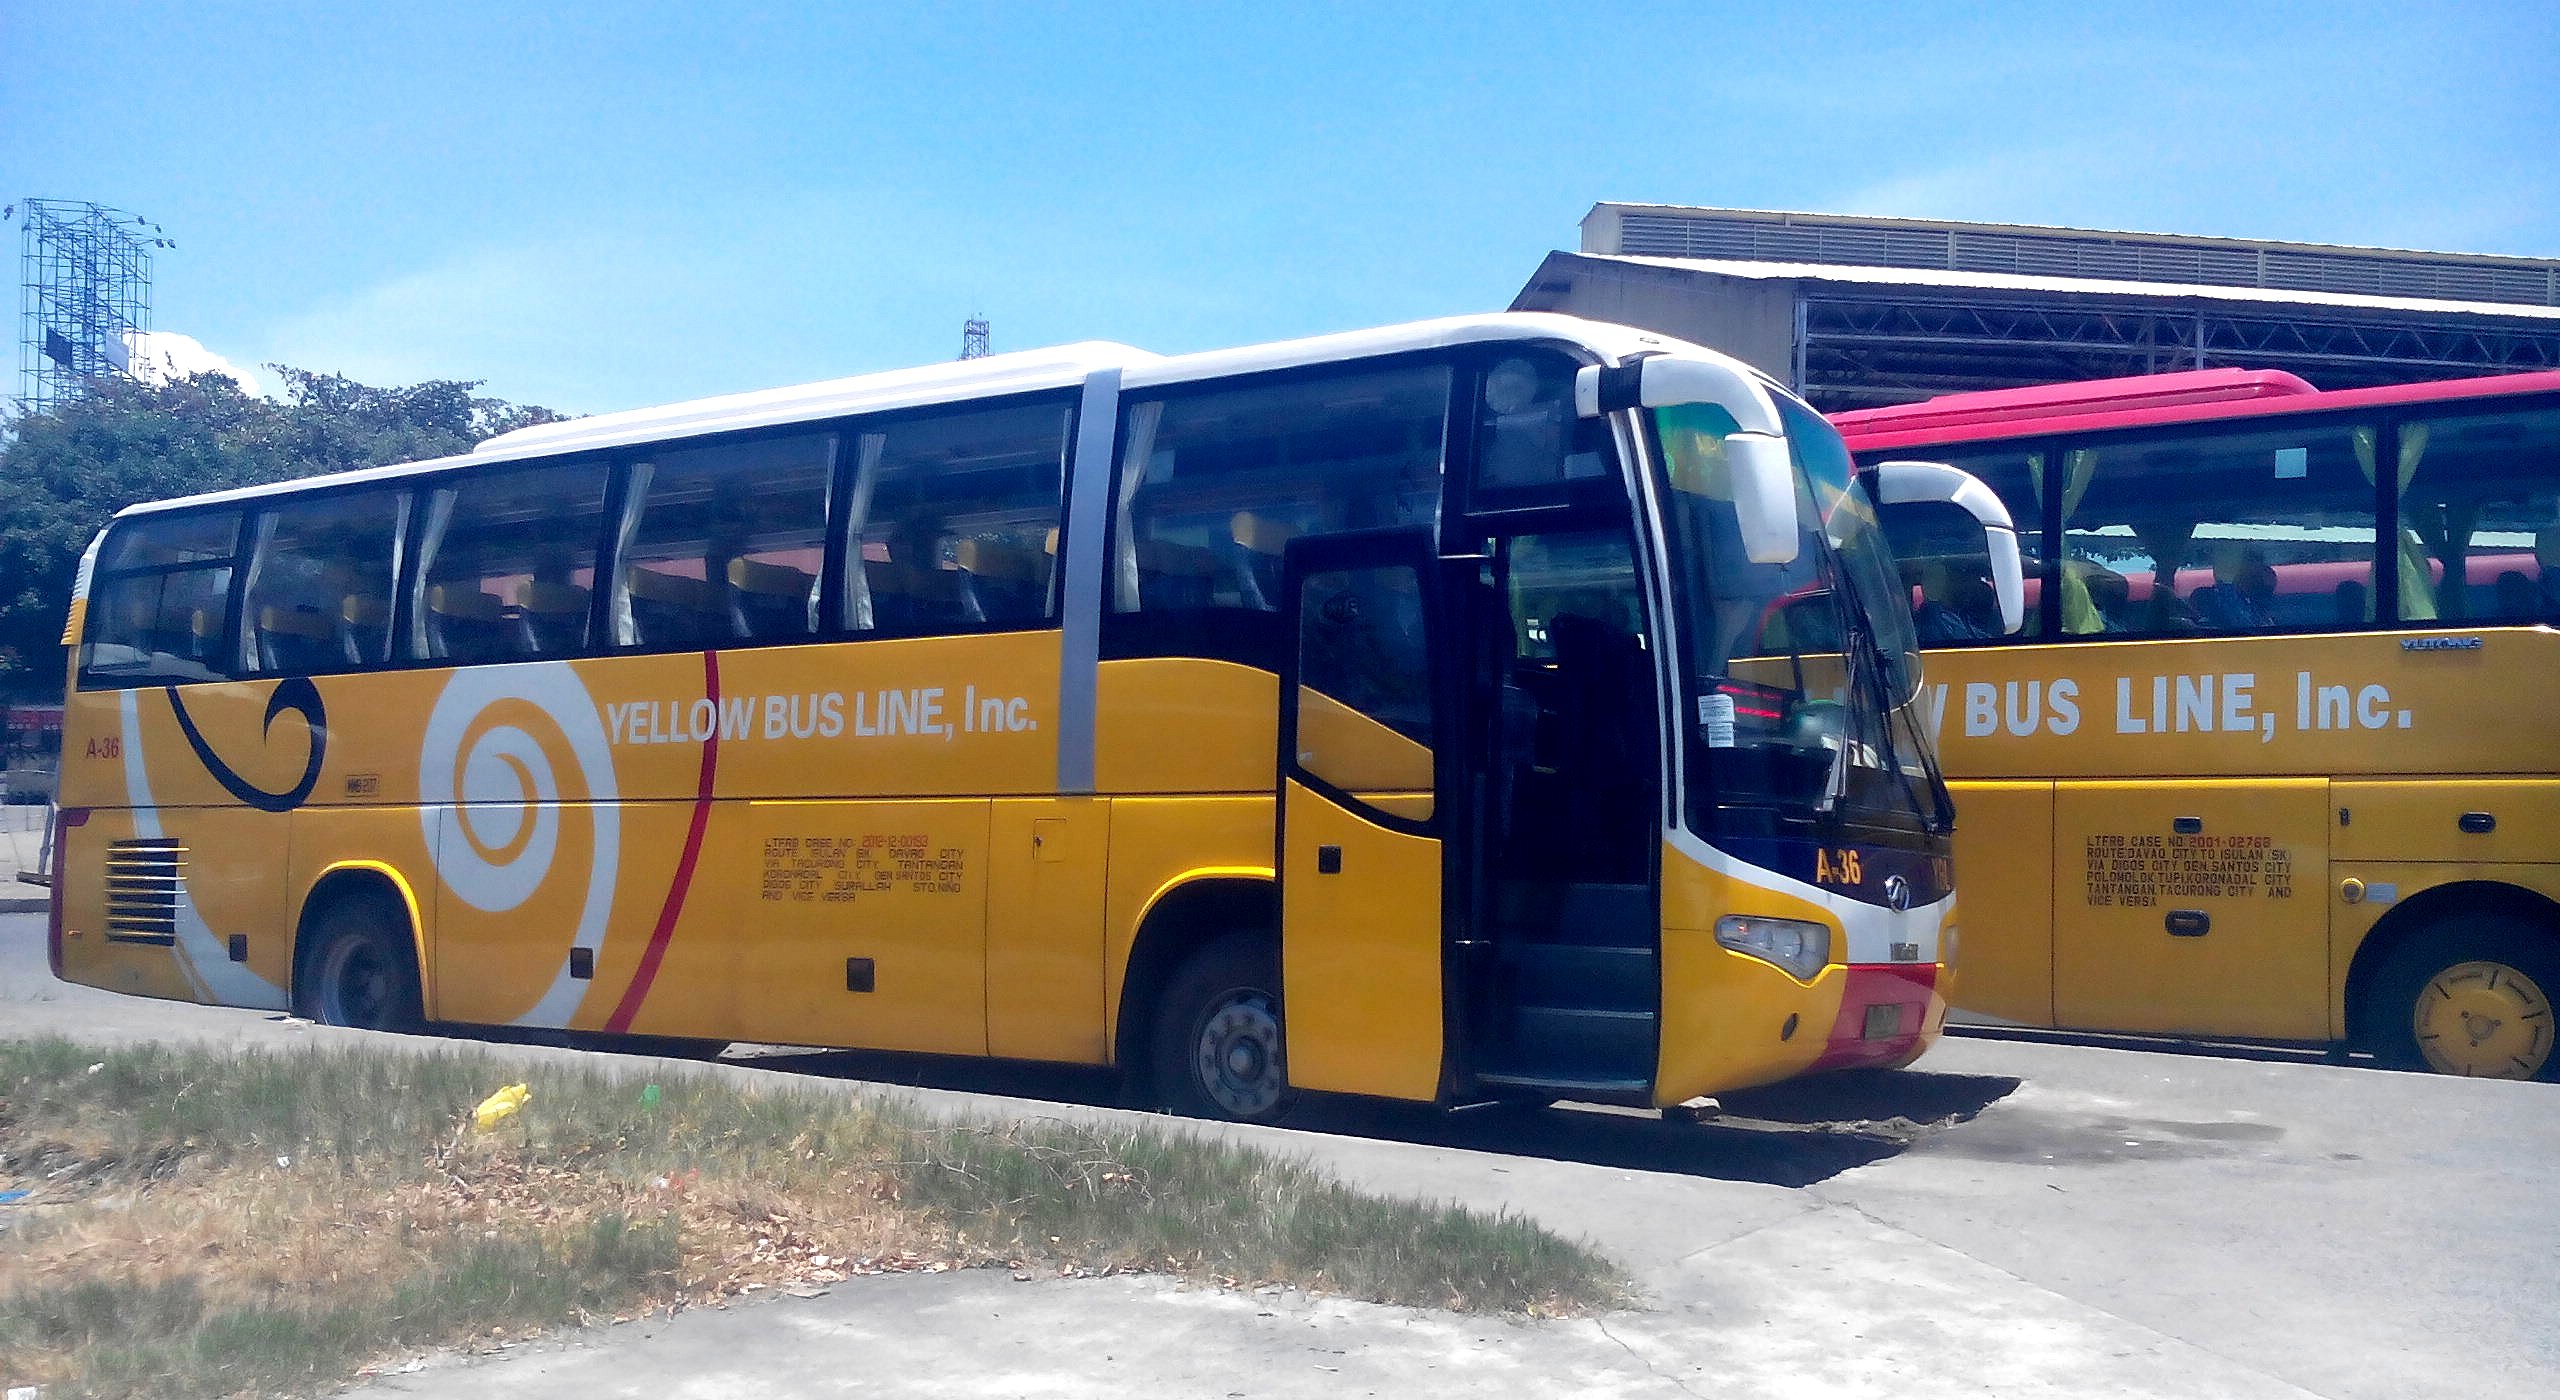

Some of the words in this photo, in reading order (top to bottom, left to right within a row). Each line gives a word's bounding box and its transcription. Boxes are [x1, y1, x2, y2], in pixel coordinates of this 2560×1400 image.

[1965, 679, 2081, 737] BUS
[2116, 673, 2276, 744] LINE,
[2296, 671, 2413, 730] Inc.
[606, 696, 757, 745] YELLOW
[764, 692, 844, 740] BUS
[855, 687, 954, 743] LINE,
[965, 684, 1038, 733] Inc.
[86, 737, 120, 759] A-36
[764, 838, 799, 848] LTFRB
[805, 838, 832, 848] CASE
[2087, 835, 2125, 847] LTFRB
[2131, 836, 2161, 848] CASE
[940, 848, 964, 859] CITY
[2172, 848, 2197, 859] CITY
[2200, 848, 2216, 859] TO
[2220, 848, 2263, 860] ISULAN
[1816, 848, 1862, 885] A-36
[2087, 859, 2105, 870] VIA
[2111, 860, 2145, 871] DIGOS
[2151, 860, 2177, 871] CITY
[2264, 861, 2292, 874] CITY
[938, 872, 963, 882] CITY
[2264, 874, 2292, 885] CITY
[2227, 886, 2254, 897] CITY
[2267, 886, 2292, 898] AND
[2087, 895, 2113, 905] VICE
[2119, 896, 2157, 906] VERSA
